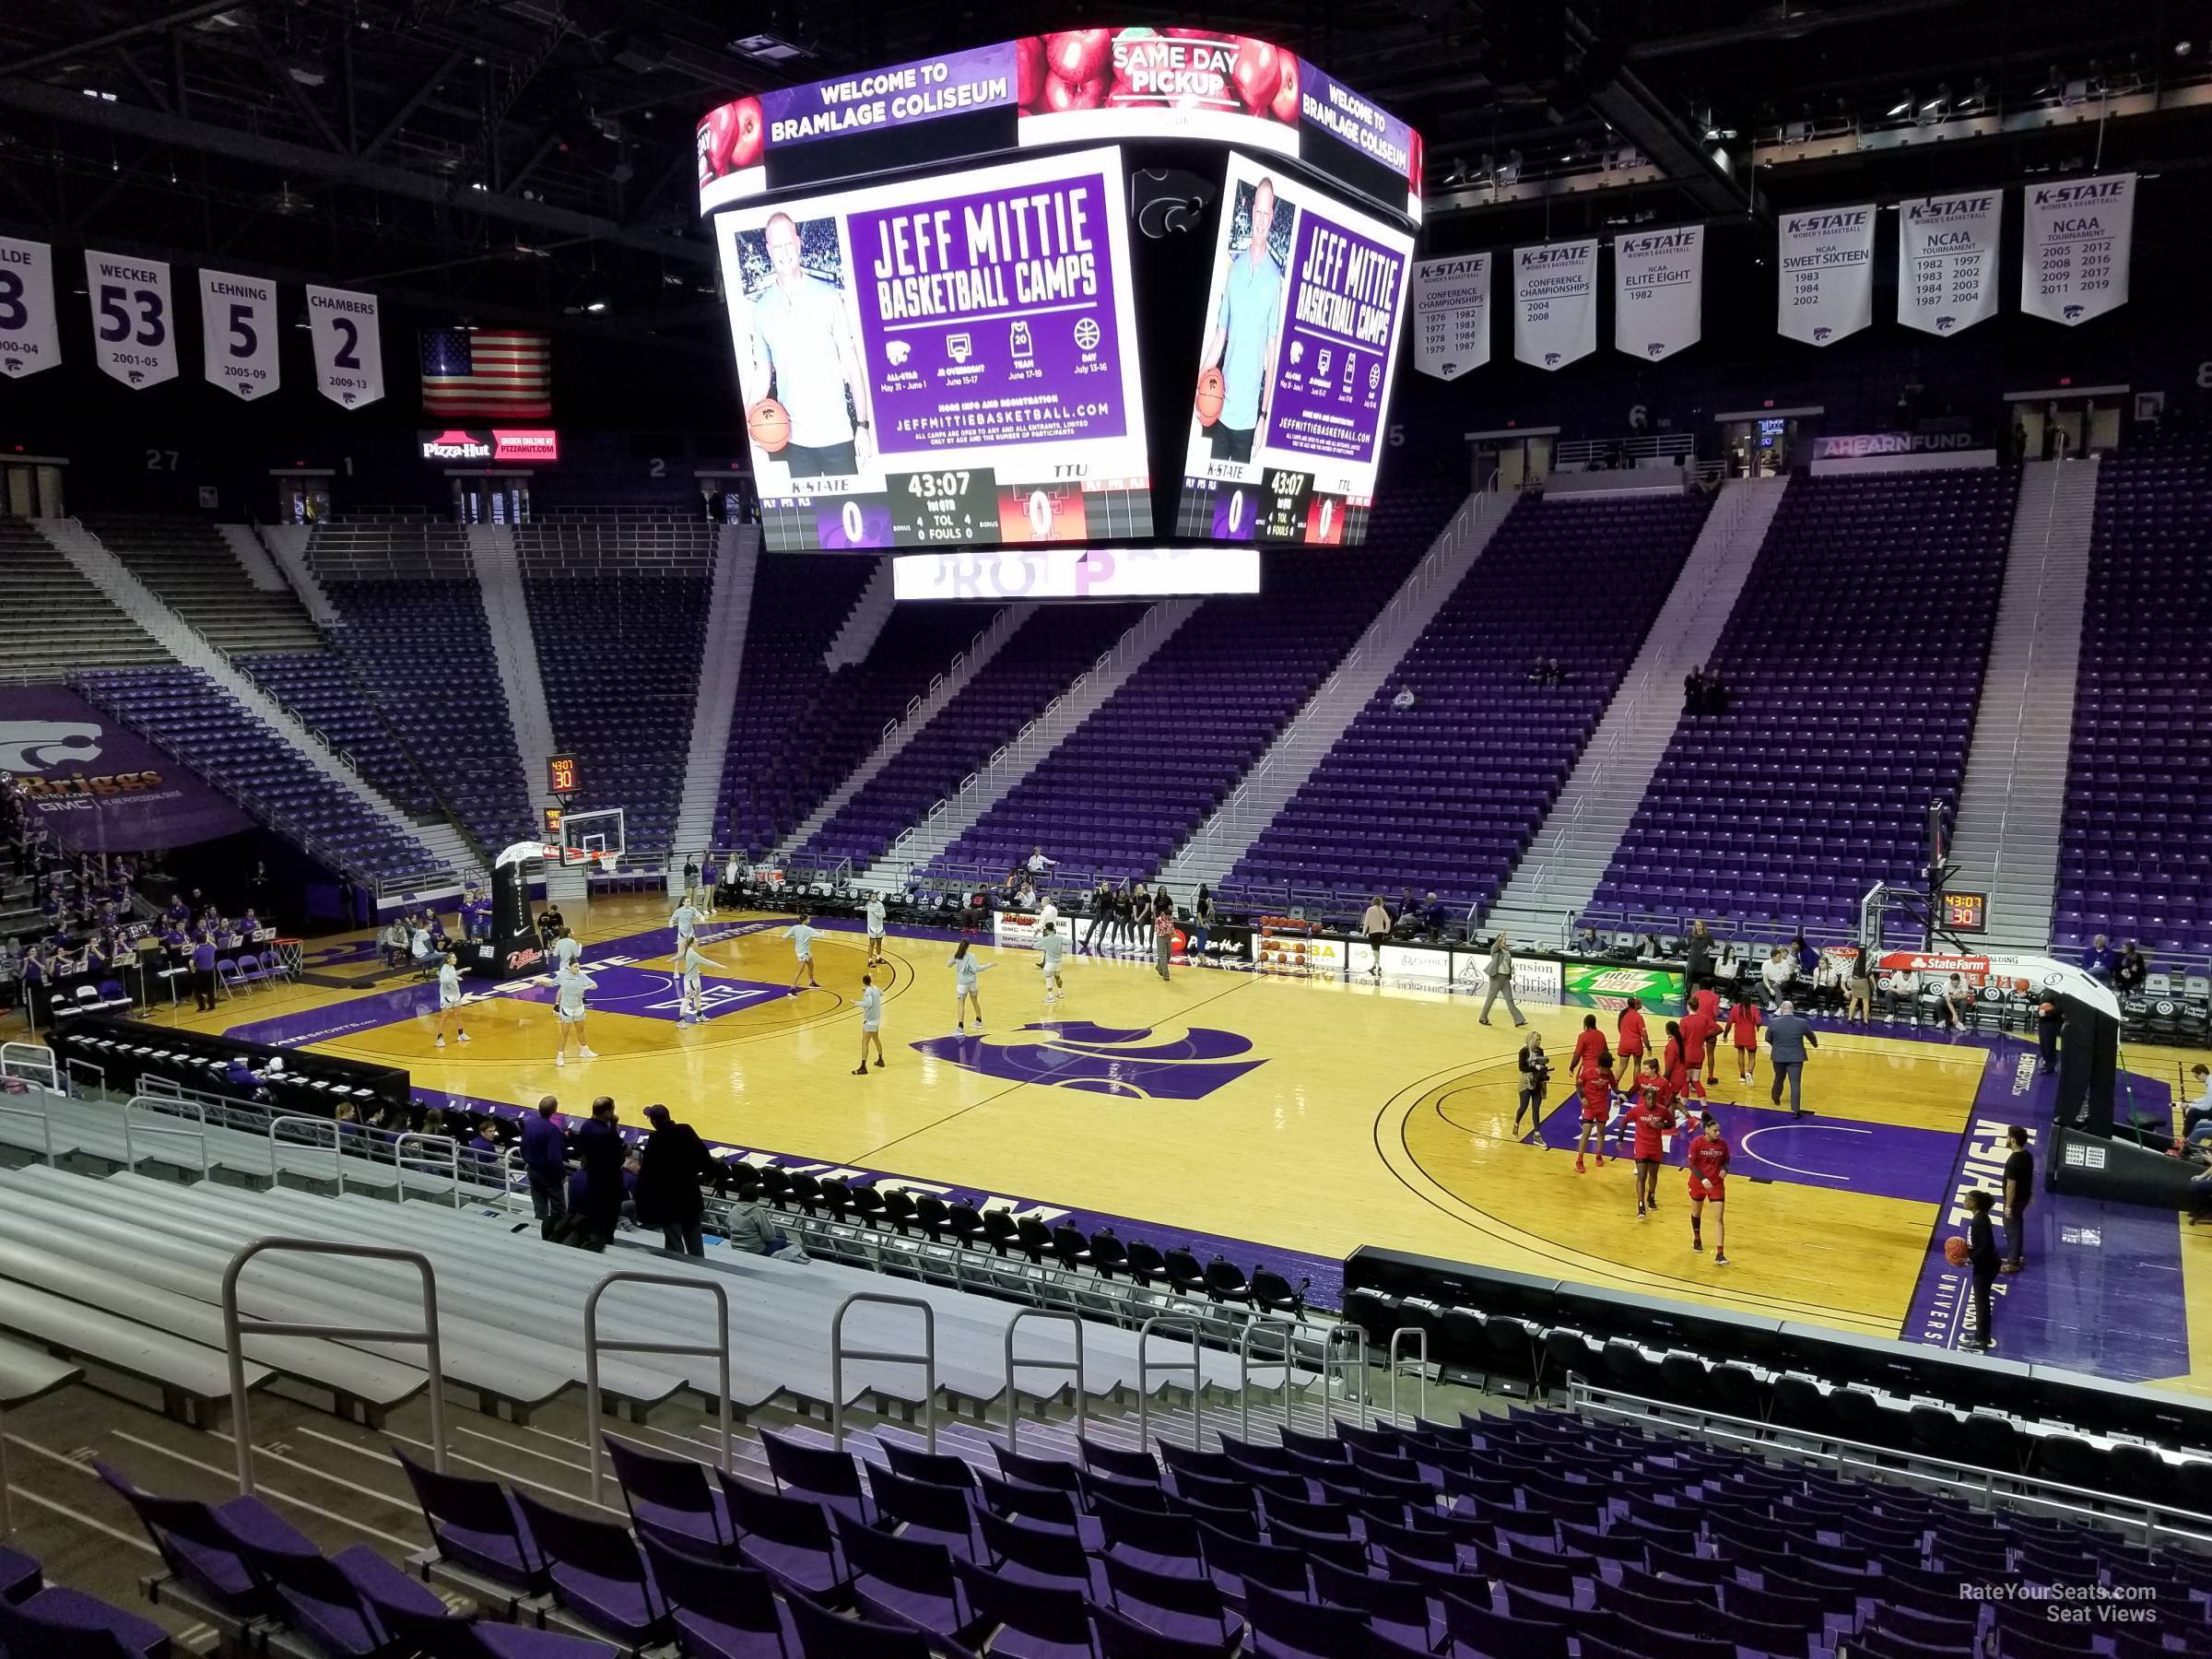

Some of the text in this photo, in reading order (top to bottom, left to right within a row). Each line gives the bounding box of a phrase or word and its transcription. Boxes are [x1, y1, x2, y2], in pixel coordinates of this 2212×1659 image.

[1112, 46, 1240, 75] SAME DAY
[820, 63, 948, 104] WELCOME TO
[1132, 71, 1225, 95] PICKUP
[771, 77, 1007, 142] BRAMLAGE COLISEUM
[1329, 83, 1385, 133] WELCOME TO
[1302, 92, 1406, 171] BRAMLAGE COLISEUM
[2034, 181, 2126, 205] K-STATE
[1908, 197, 1994, 219] K-STATE
[1788, 211, 1867, 233] K-STATE
[2053, 217, 2100, 233] NCAA
[875, 187, 1092, 278] JEFF MITTIE
[1793, 226, 1861, 240] WOMEN'S BASKETBALL
[1927, 231, 1971, 247] NCAA
[2048, 229, 2106, 241] TOURNAMENT
[1622, 232, 1696, 253] K-STATE
[1816, 245, 1836, 253] NCAA
[1922, 242, 1976, 254] TOURNAMENT
[2042, 241, 2111, 257] 2005 2012
[0, 249, 32, 265] LDE
[1521, 245, 1591, 266] K-STATE
[1627, 247, 1689, 259] WOMEN'S BASKETBALL
[1783, 249, 1869, 268] SWEET SIXTEEN
[1301, 226, 1399, 312] JEFF MITTIE
[1419, 259, 1485, 278] K-STATE
[1648, 265, 1667, 273] NCAA
[1917, 255, 1981, 270] 1982 1997
[2041, 254, 2111, 270] 2008 2016
[100, 264, 158, 284] WECKER
[1528, 275, 1583, 288] CONFERENCE
[1625, 270, 1690, 287] ELITE EIGHT
[1794, 272, 1819, 282] 1983
[1917, 267, 1980, 282] 1983 2002
[2041, 267, 2110, 282] 2009 2017
[211, 281, 267, 300] LEHNING
[877, 253, 1098, 321] BASKETBALL CAMPS
[1427, 288, 1477, 300] CONFERENCE
[1520, 283, 1590, 298] CHAMPIONSHIPS
[1630, 290, 1653, 300] 1982
[1794, 284, 1818, 294] 1984
[1917, 280, 1979, 294] 1984 2003
[2041, 279, 2110, 295] 2011 2019
[311, 295, 374, 314] CHAMBERS
[1418, 295, 1484, 310] CHAMPIONSHIPS
[1527, 301, 1549, 312] 2004
[1793, 296, 1818, 306] 2002
[1916, 292, 1979, 306] 1987 2004
[100, 284, 165, 347] 53
[1295, 281, 1391, 347] BASKETBALL CAMPS
[1426, 311, 1476, 324] 1976 1982
[1527, 312, 1549, 323] 2008
[229, 303, 257, 358] 5
[1426, 321, 1476, 334] 1977 1983
[332, 317, 360, 370] 2
[1015, 334, 1028, 345] 20
[1426, 332, 1475, 344] 1978 1984
[1426, 342, 1475, 355] 1979 1987
[112, 352, 159, 367] 2001-05
[224, 365, 266, 379] 2005-09
[1074, 365, 1089, 374] July
[329, 376, 367, 389] 2009-13
[897, 402, 1109, 431] JEFFMITTIEBASKETBALL.COM
[1629, 405, 1648, 429] 6
[1278, 418, 1371, 443] JEFFMITTIEBASKETBALL.COM
[1389, 425, 1406, 447] 5
[423, 441, 491, 459] Pizza Hut
[500, 445, 554, 453] PIZZAHUT.COM
[146, 449, 181, 471] 27
[344, 456, 354, 477] 1
[649, 457, 665, 477] 2
[1053, 464, 1088, 477] TTU
[1206, 462, 1244, 479] K-STATE
[792, 479, 850, 494] K-STATE
[908, 471, 971, 498] 43:07
[1271, 471, 1304, 496] 43:07
[1029, 490, 1053, 535] 0
[1228, 489, 1243, 534] 0
[1277, 512, 1288, 524] TOL
[1319, 499, 1333, 538] 0
[841, 501, 863, 543] 0
[916, 513, 971, 527] 4 TOL 4
[929, 527, 961, 539] FOULS
[1272, 525, 1289, 536] FOULS
[551, 759, 572, 771] 43:07
[556, 771, 571, 789] 30
[38, 799, 93, 811] GMC
[1946, 895, 1982, 909] 43:07
[1952, 909, 1973, 924] 30
[1219, 938, 1244, 952] Hut
[1512, 961, 1554, 974] ension
[1988, 956, 2018, 965] ALDING
[1512, 974, 1557, 988] Christi
